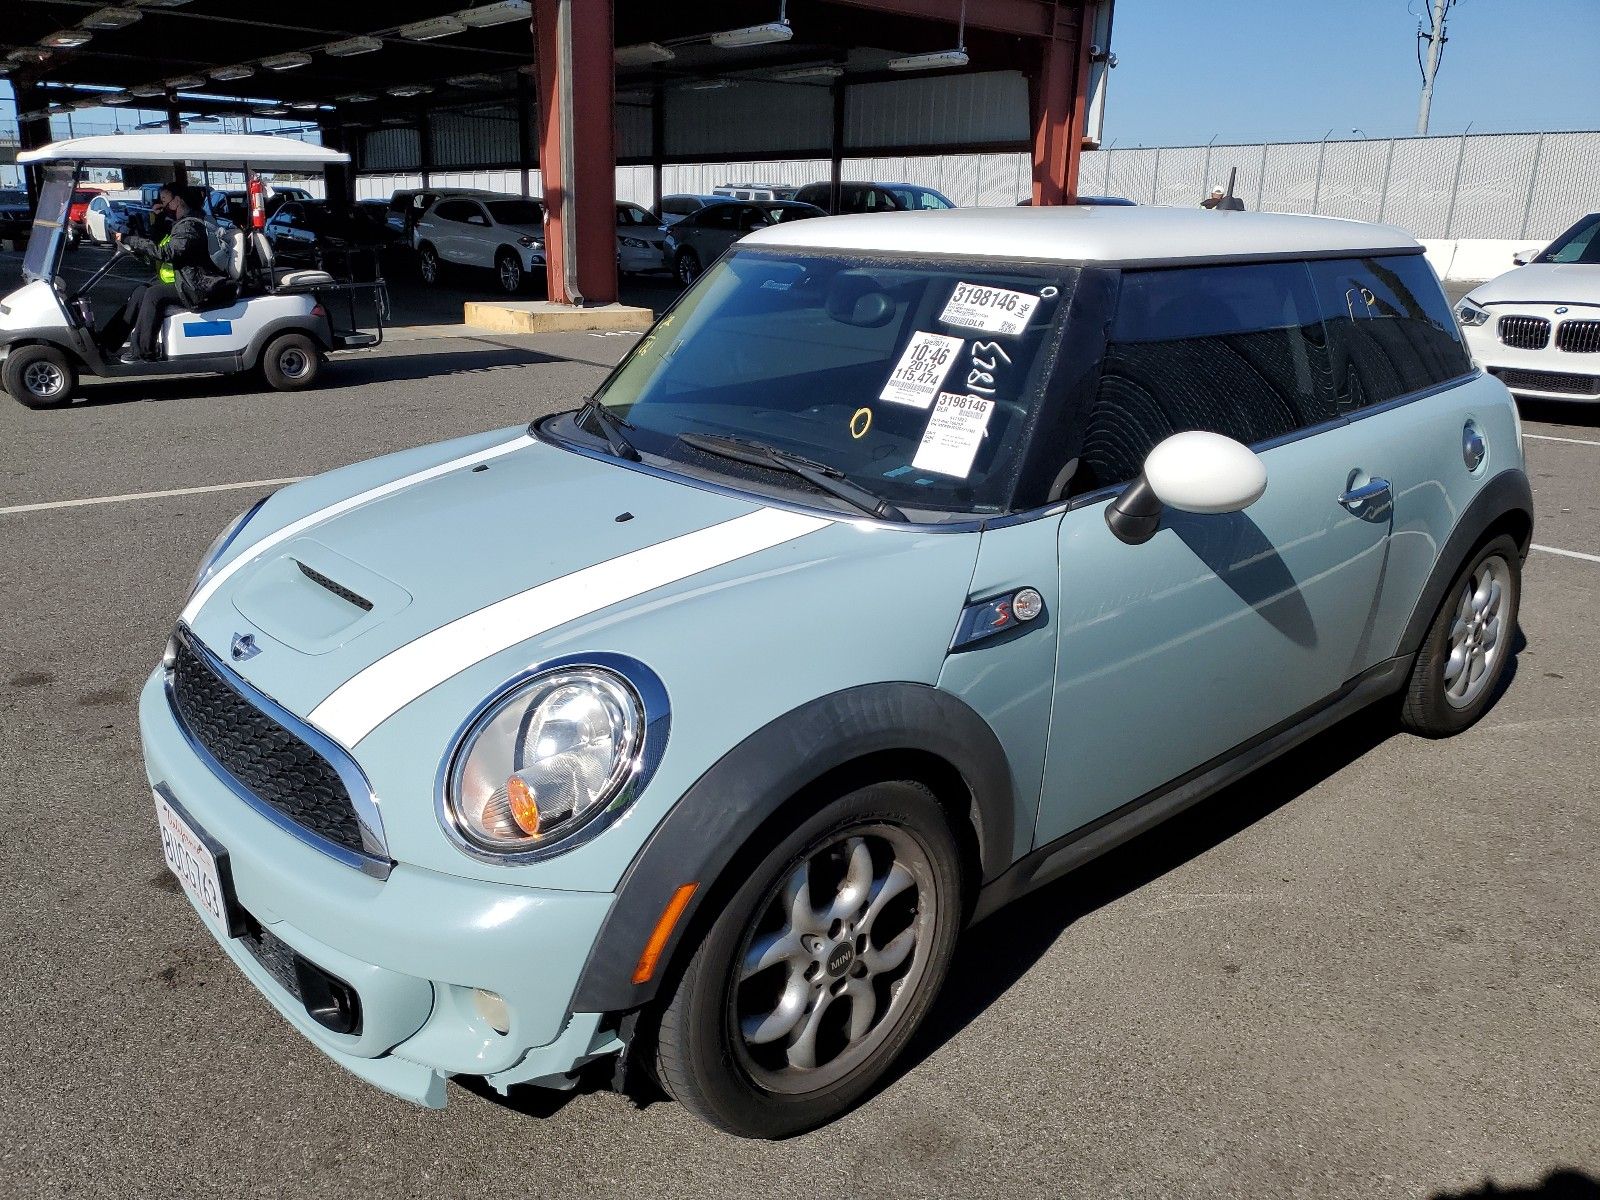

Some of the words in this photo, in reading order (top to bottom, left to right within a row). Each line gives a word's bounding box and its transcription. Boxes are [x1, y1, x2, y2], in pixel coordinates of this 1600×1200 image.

[953, 286, 1020, 311] 3198146
[910, 343, 951, 366] 10:46
[908, 360, 937, 374] 2012
[939, 394, 988, 413] 3198146
[831, 951, 850, 970] MINI
